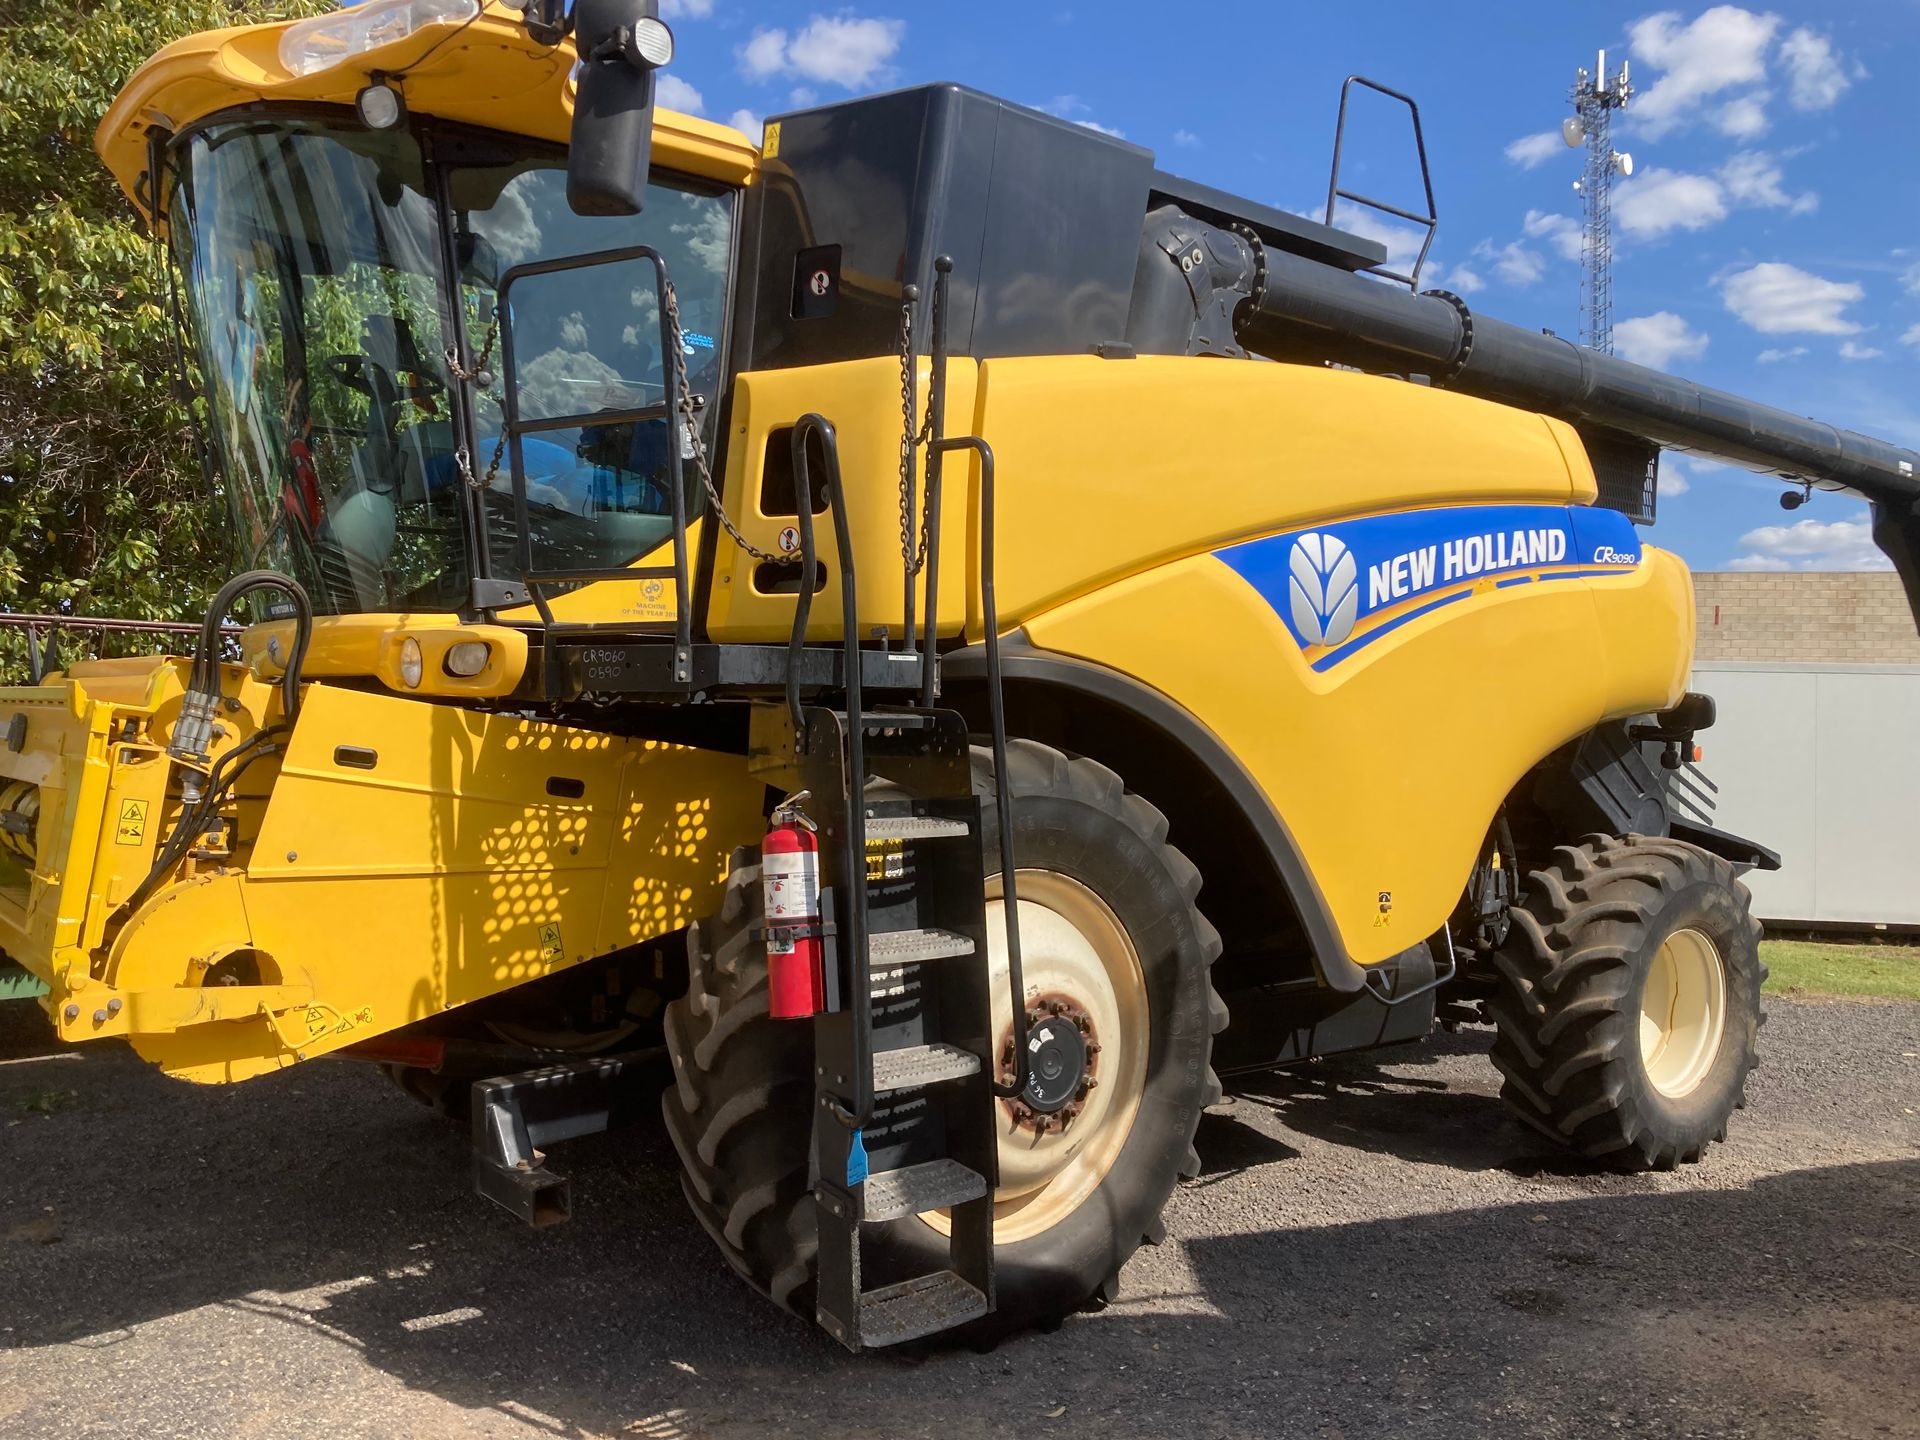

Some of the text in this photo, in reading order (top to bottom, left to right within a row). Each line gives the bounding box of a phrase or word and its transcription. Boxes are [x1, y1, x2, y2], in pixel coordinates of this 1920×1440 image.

[1593, 545, 1636, 564] CR9090
[1369, 528, 1566, 609] NEW HOLLAND
[635, 602, 667, 610] MACHINE
[582, 649, 626, 664] CR9060
[588, 665, 621, 679] 0590
